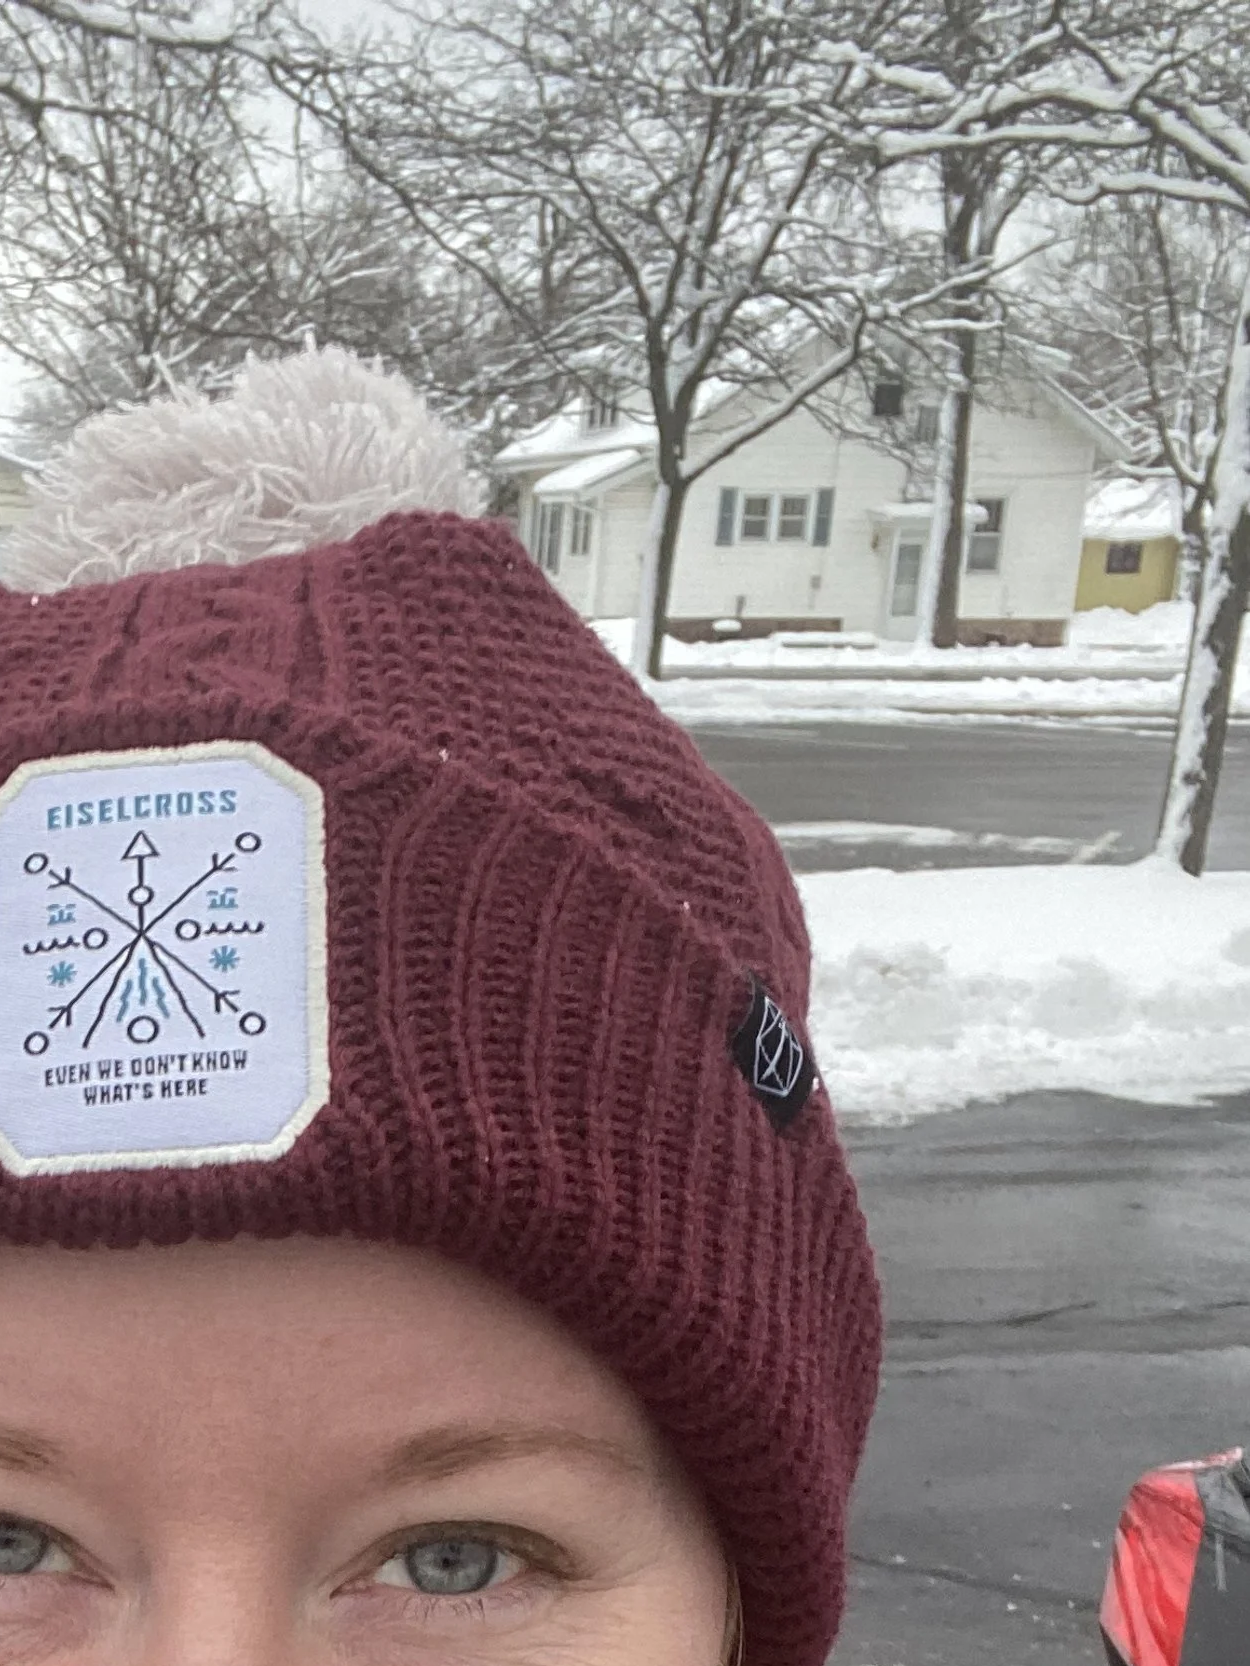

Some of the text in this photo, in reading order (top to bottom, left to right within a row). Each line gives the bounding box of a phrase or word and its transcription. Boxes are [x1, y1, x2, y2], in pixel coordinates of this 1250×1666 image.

[47, 789, 237, 830] EISELCROSS
[44, 1049, 249, 1087] EVEN WE DON'T KNOW
[83, 1078, 209, 1106] WHAT'S HERE
